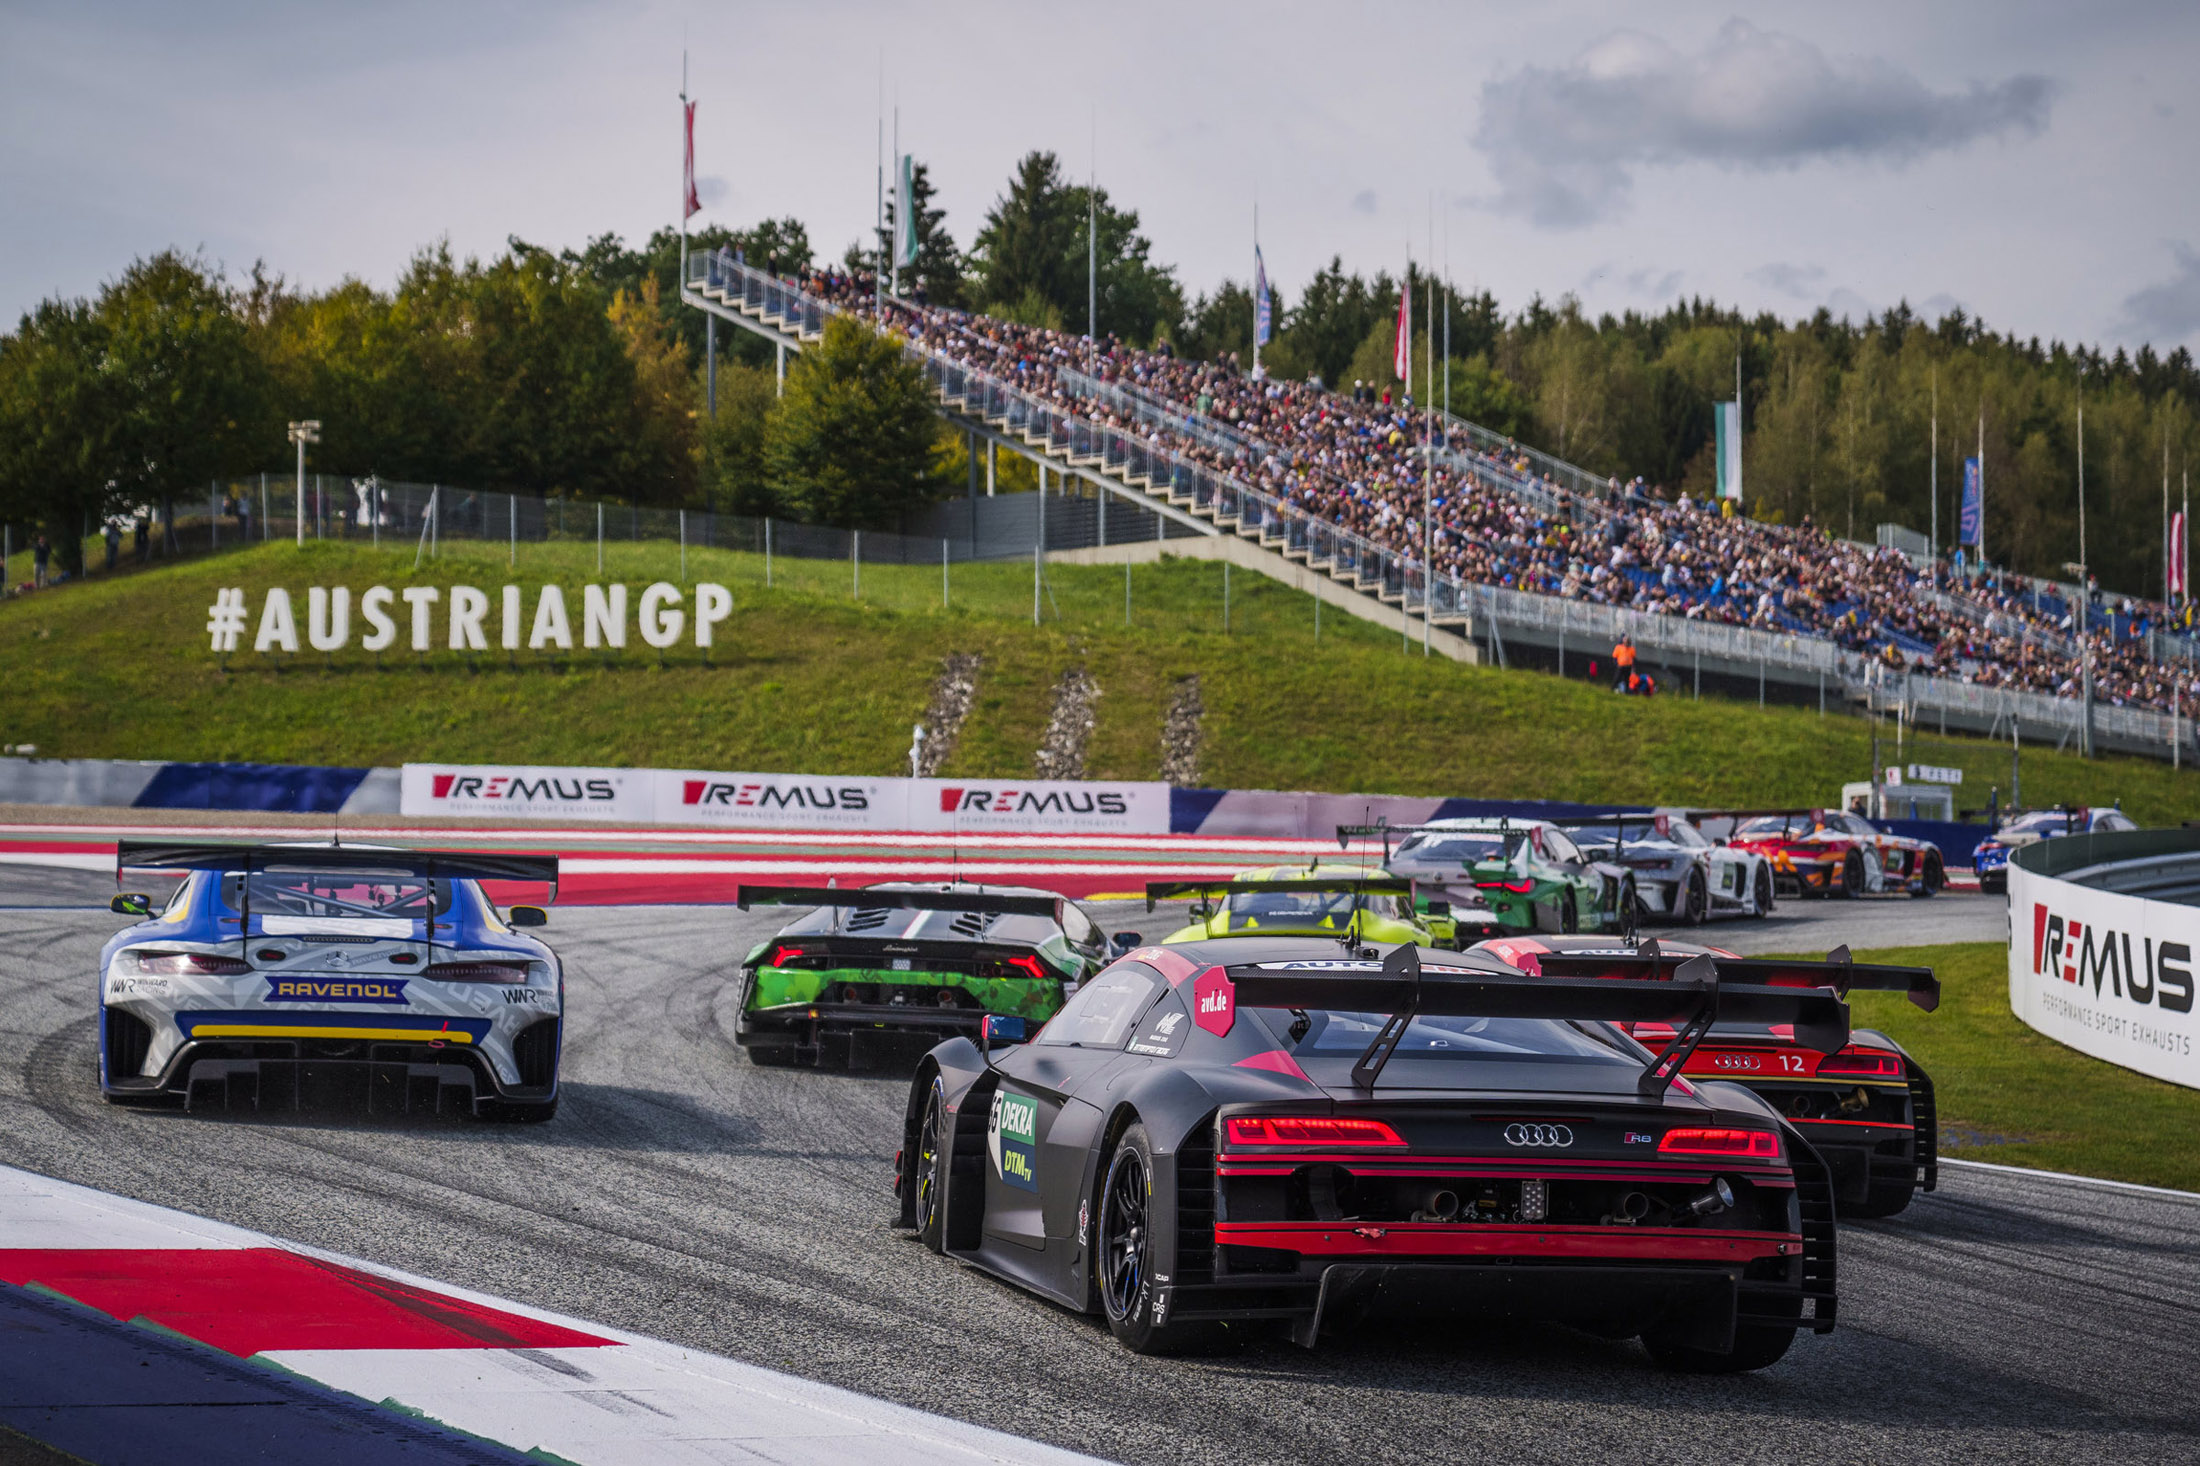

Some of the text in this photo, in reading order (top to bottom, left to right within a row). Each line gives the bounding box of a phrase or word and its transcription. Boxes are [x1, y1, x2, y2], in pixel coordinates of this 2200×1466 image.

[207, 582, 732, 652] #AUSTRIANGP
[453, 777, 614, 800] REMUS
[704, 783, 868, 810] REMUS
[963, 790, 1127, 814] REMUS
[2043, 914, 2194, 1014] REMUS
[278, 982, 397, 998] RAVENOL
[1201, 989, 1227, 1013] avd.de
[2096, 1011, 2127, 1039] SPORT
[2132, 1022, 2190, 1056] EXHAUSTS
[1778, 1055, 1805, 1072] 12
[1001, 1100, 1034, 1137] DEKRA
[1631, 1134, 1652, 1143] R8
[1004, 1149, 1026, 1177] DTM
